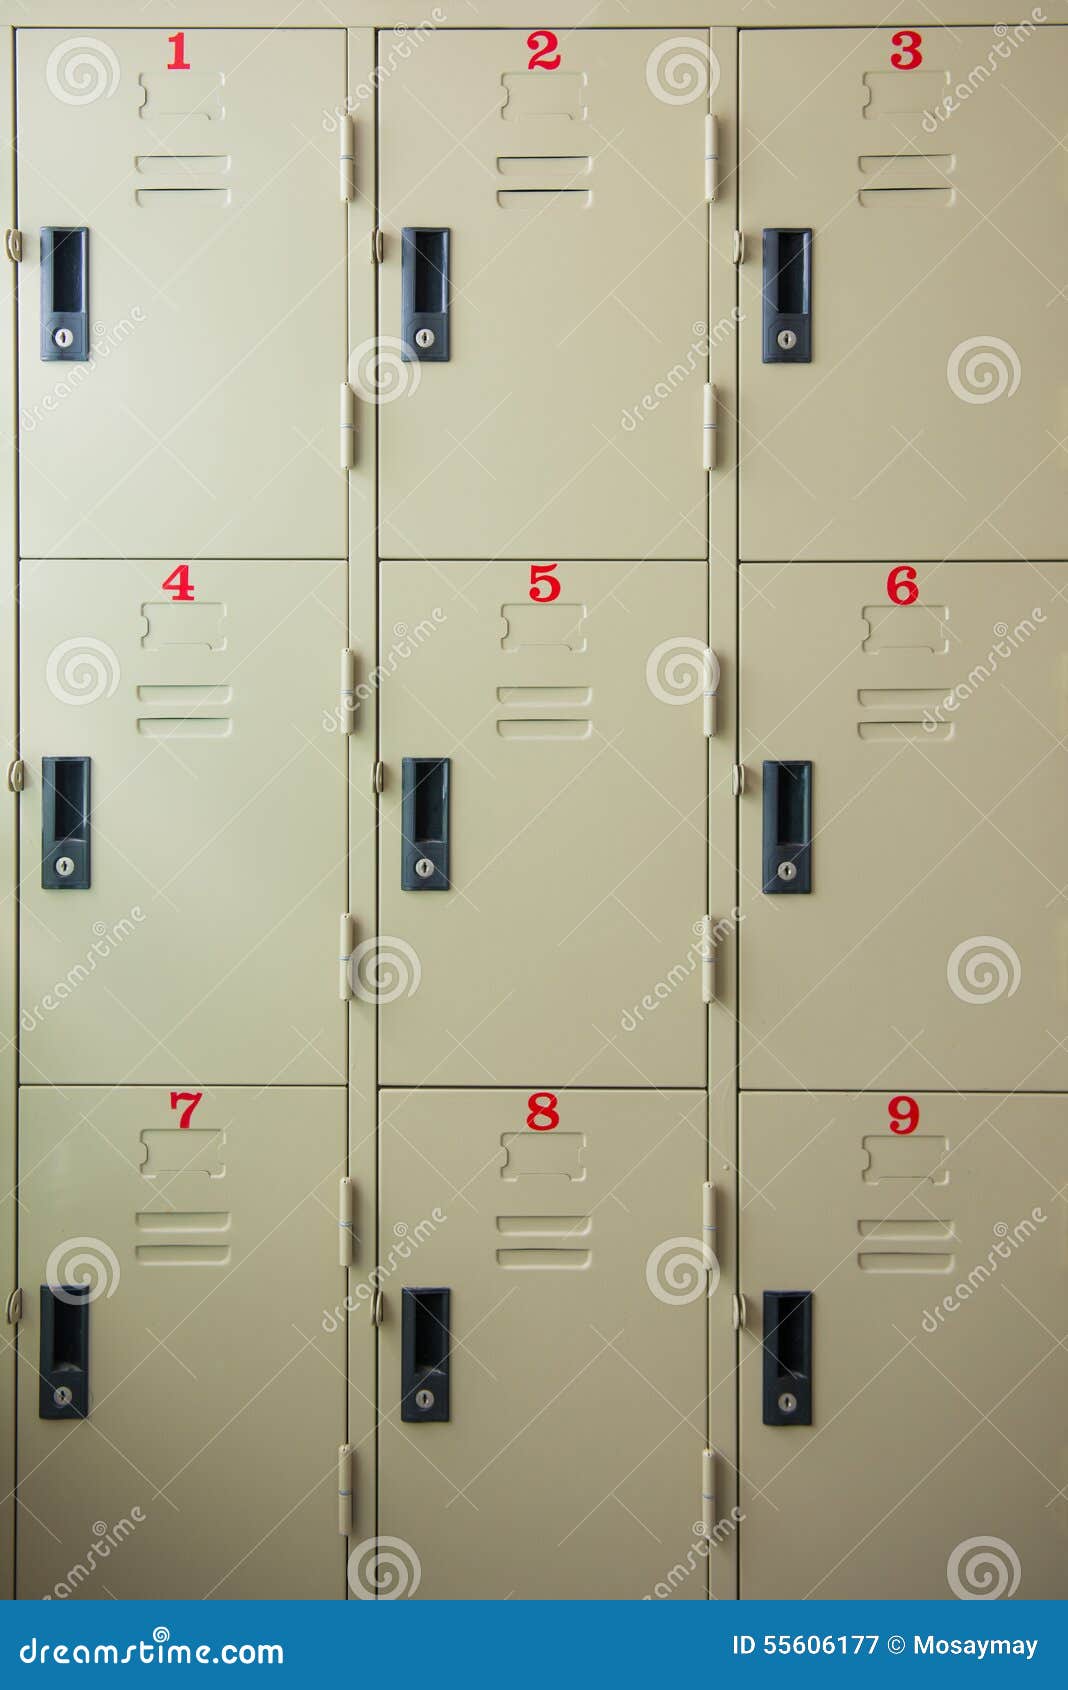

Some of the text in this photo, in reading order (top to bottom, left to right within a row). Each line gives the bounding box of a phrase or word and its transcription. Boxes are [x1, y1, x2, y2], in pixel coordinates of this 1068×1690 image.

[166, 32, 191, 70] 1
[526, 30, 562, 71] 2
[889, 30, 924, 71] 3
[161, 564, 195, 602] 4
[528, 563, 562, 603] 5
[886, 565, 920, 606] 6
[170, 1092, 204, 1129] 7
[526, 1092, 561, 1131] 8
[887, 1095, 921, 1135] 9
